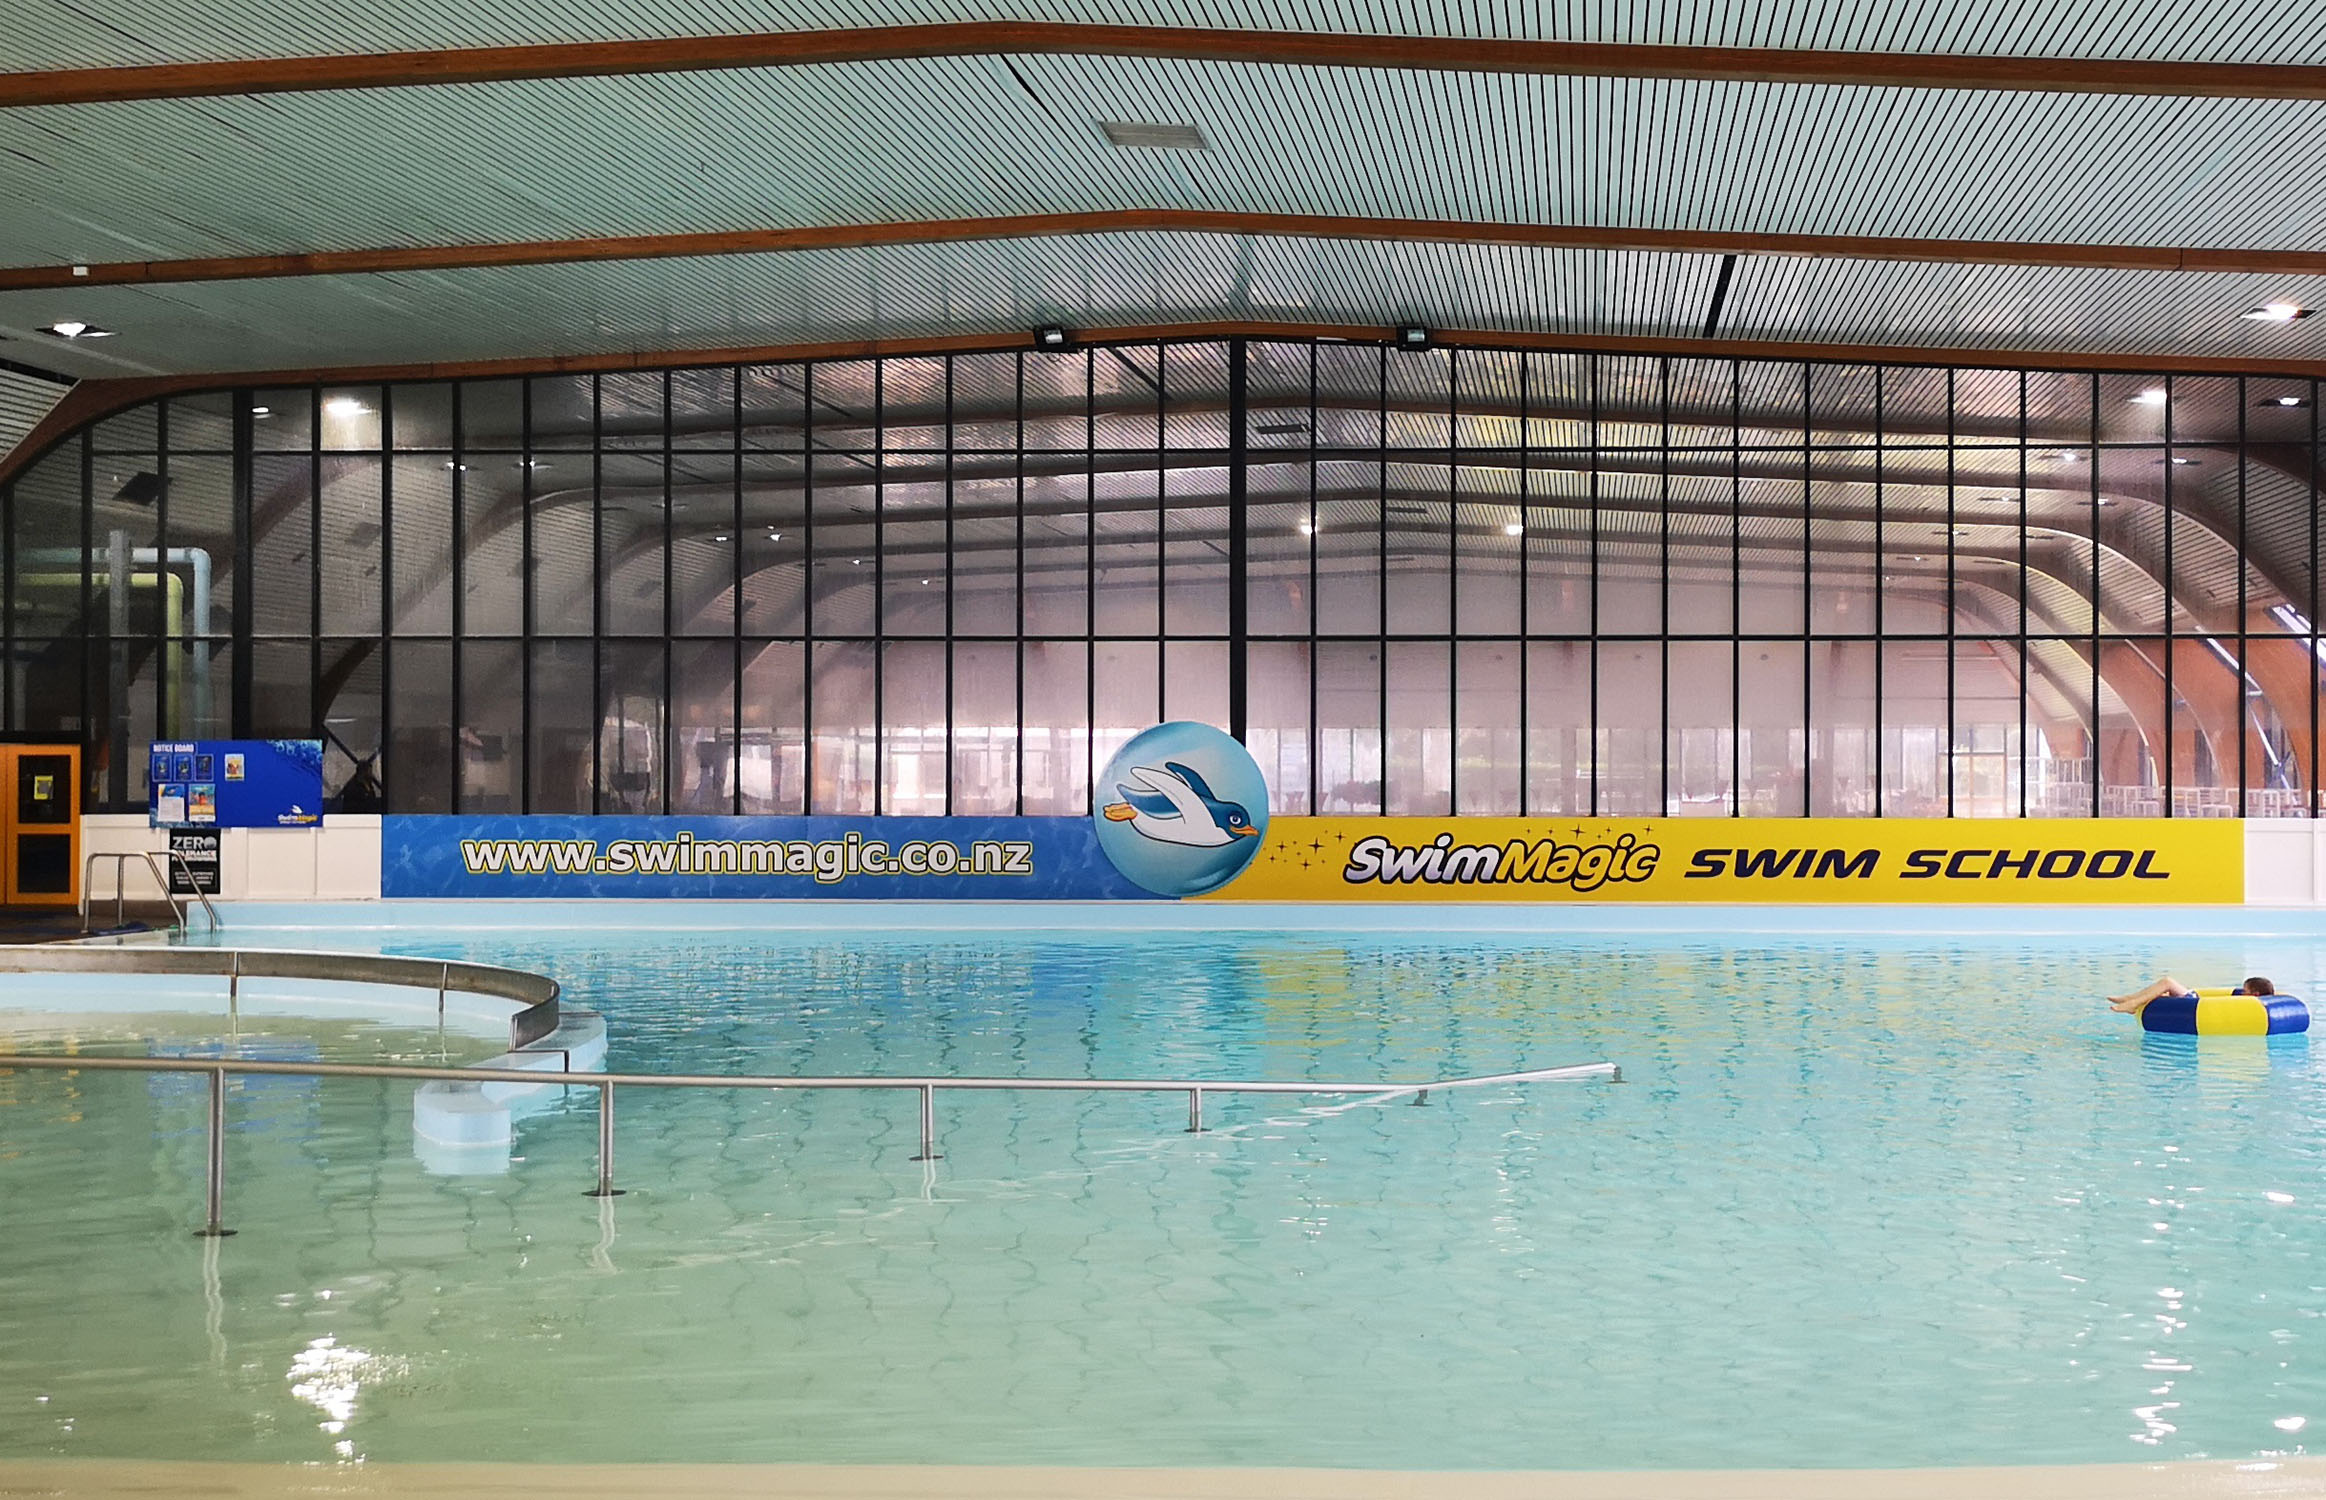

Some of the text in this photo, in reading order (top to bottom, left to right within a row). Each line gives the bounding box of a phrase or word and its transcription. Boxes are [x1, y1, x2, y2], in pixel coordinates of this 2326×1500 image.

[461, 833, 1032, 883] www.swimmagic.co.nz
[1342, 831, 1660, 892] SwimMagic
[1684, 848, 2171, 878] SWIM SCHOOL
